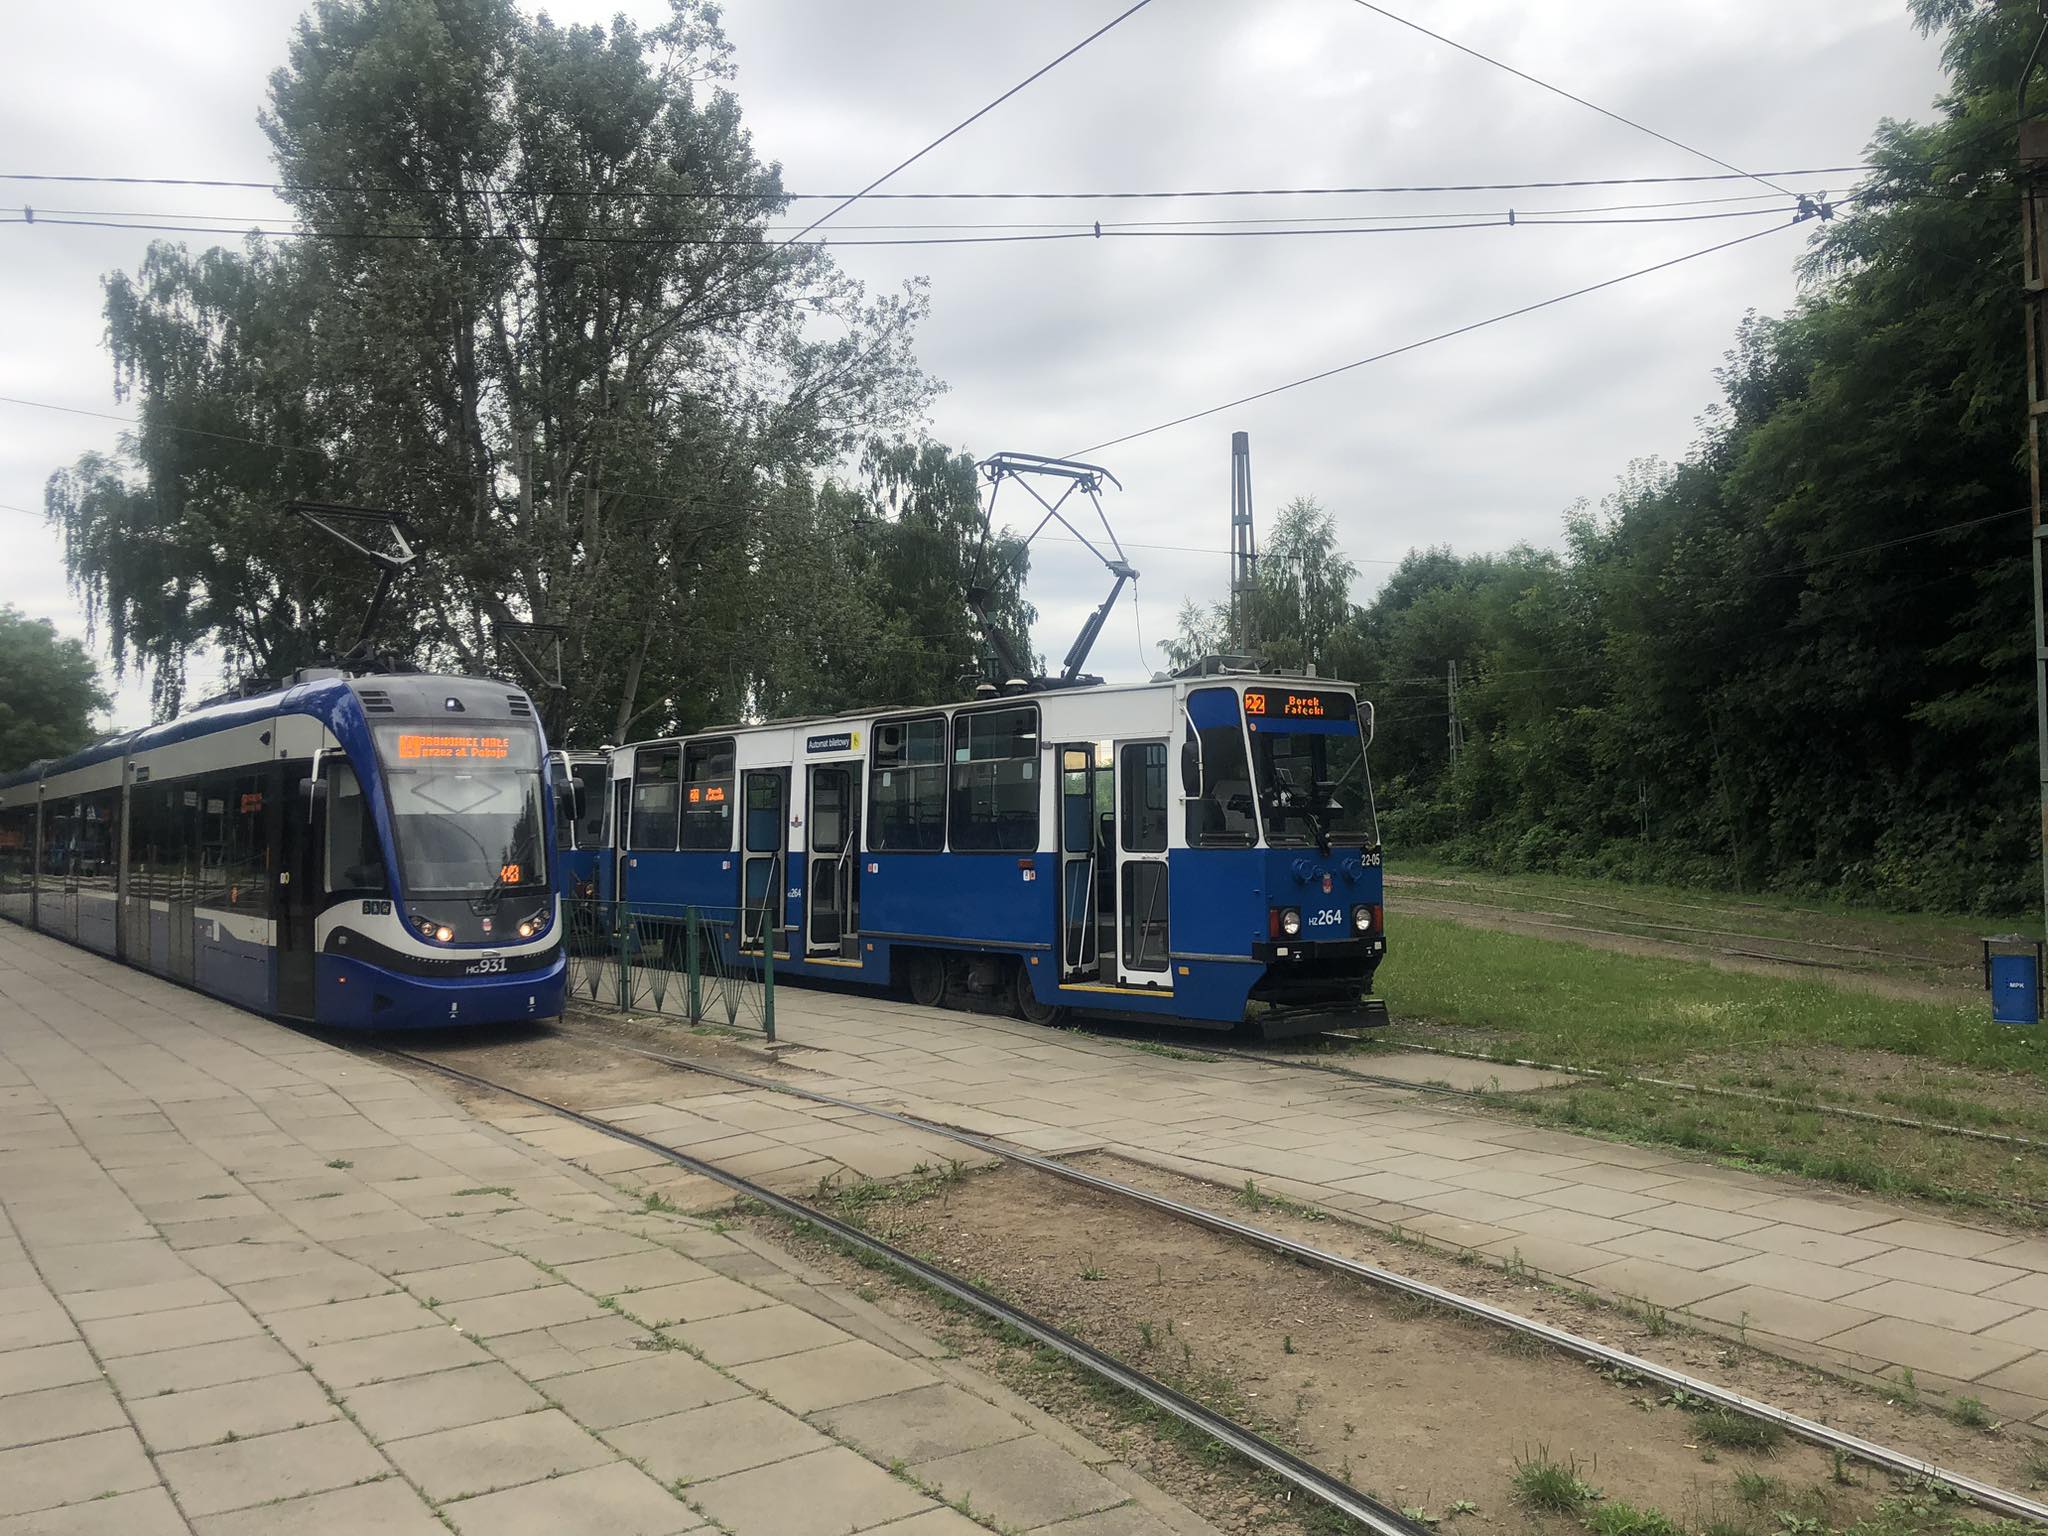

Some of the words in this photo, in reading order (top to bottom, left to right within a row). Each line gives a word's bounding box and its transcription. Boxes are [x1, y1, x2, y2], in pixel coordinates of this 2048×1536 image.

[1246, 694, 1265, 714] 22
[1289, 695, 1319, 706] Borek
[1285, 704, 1324, 715] Fałęcki
[808, 739, 829, 749] Automat
[829, 737, 849, 748] biletowy
